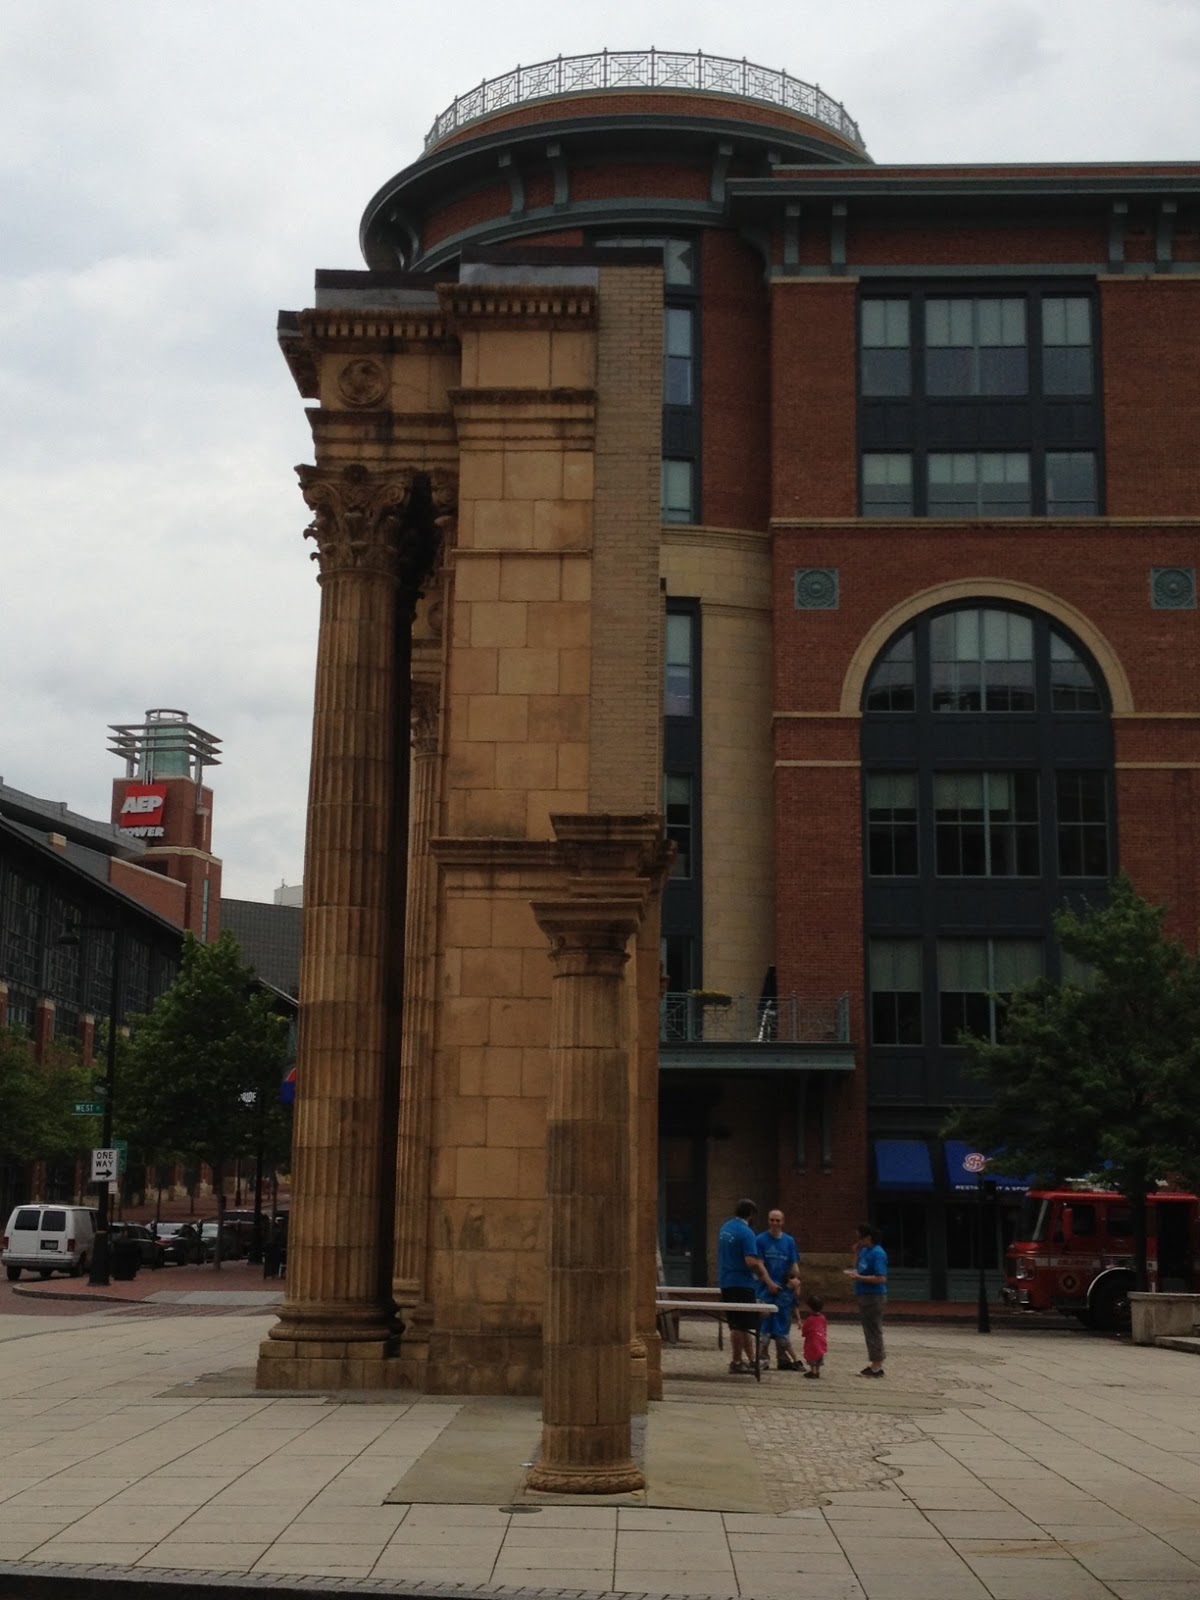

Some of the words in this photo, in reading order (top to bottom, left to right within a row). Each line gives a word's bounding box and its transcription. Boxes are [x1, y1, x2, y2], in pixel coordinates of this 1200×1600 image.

[120, 795, 163, 813] AEP
[75, 1104, 94, 1112] WEST
[96, 1151, 114, 1160] ONE
[95, 1160, 114, 1168] WAY
